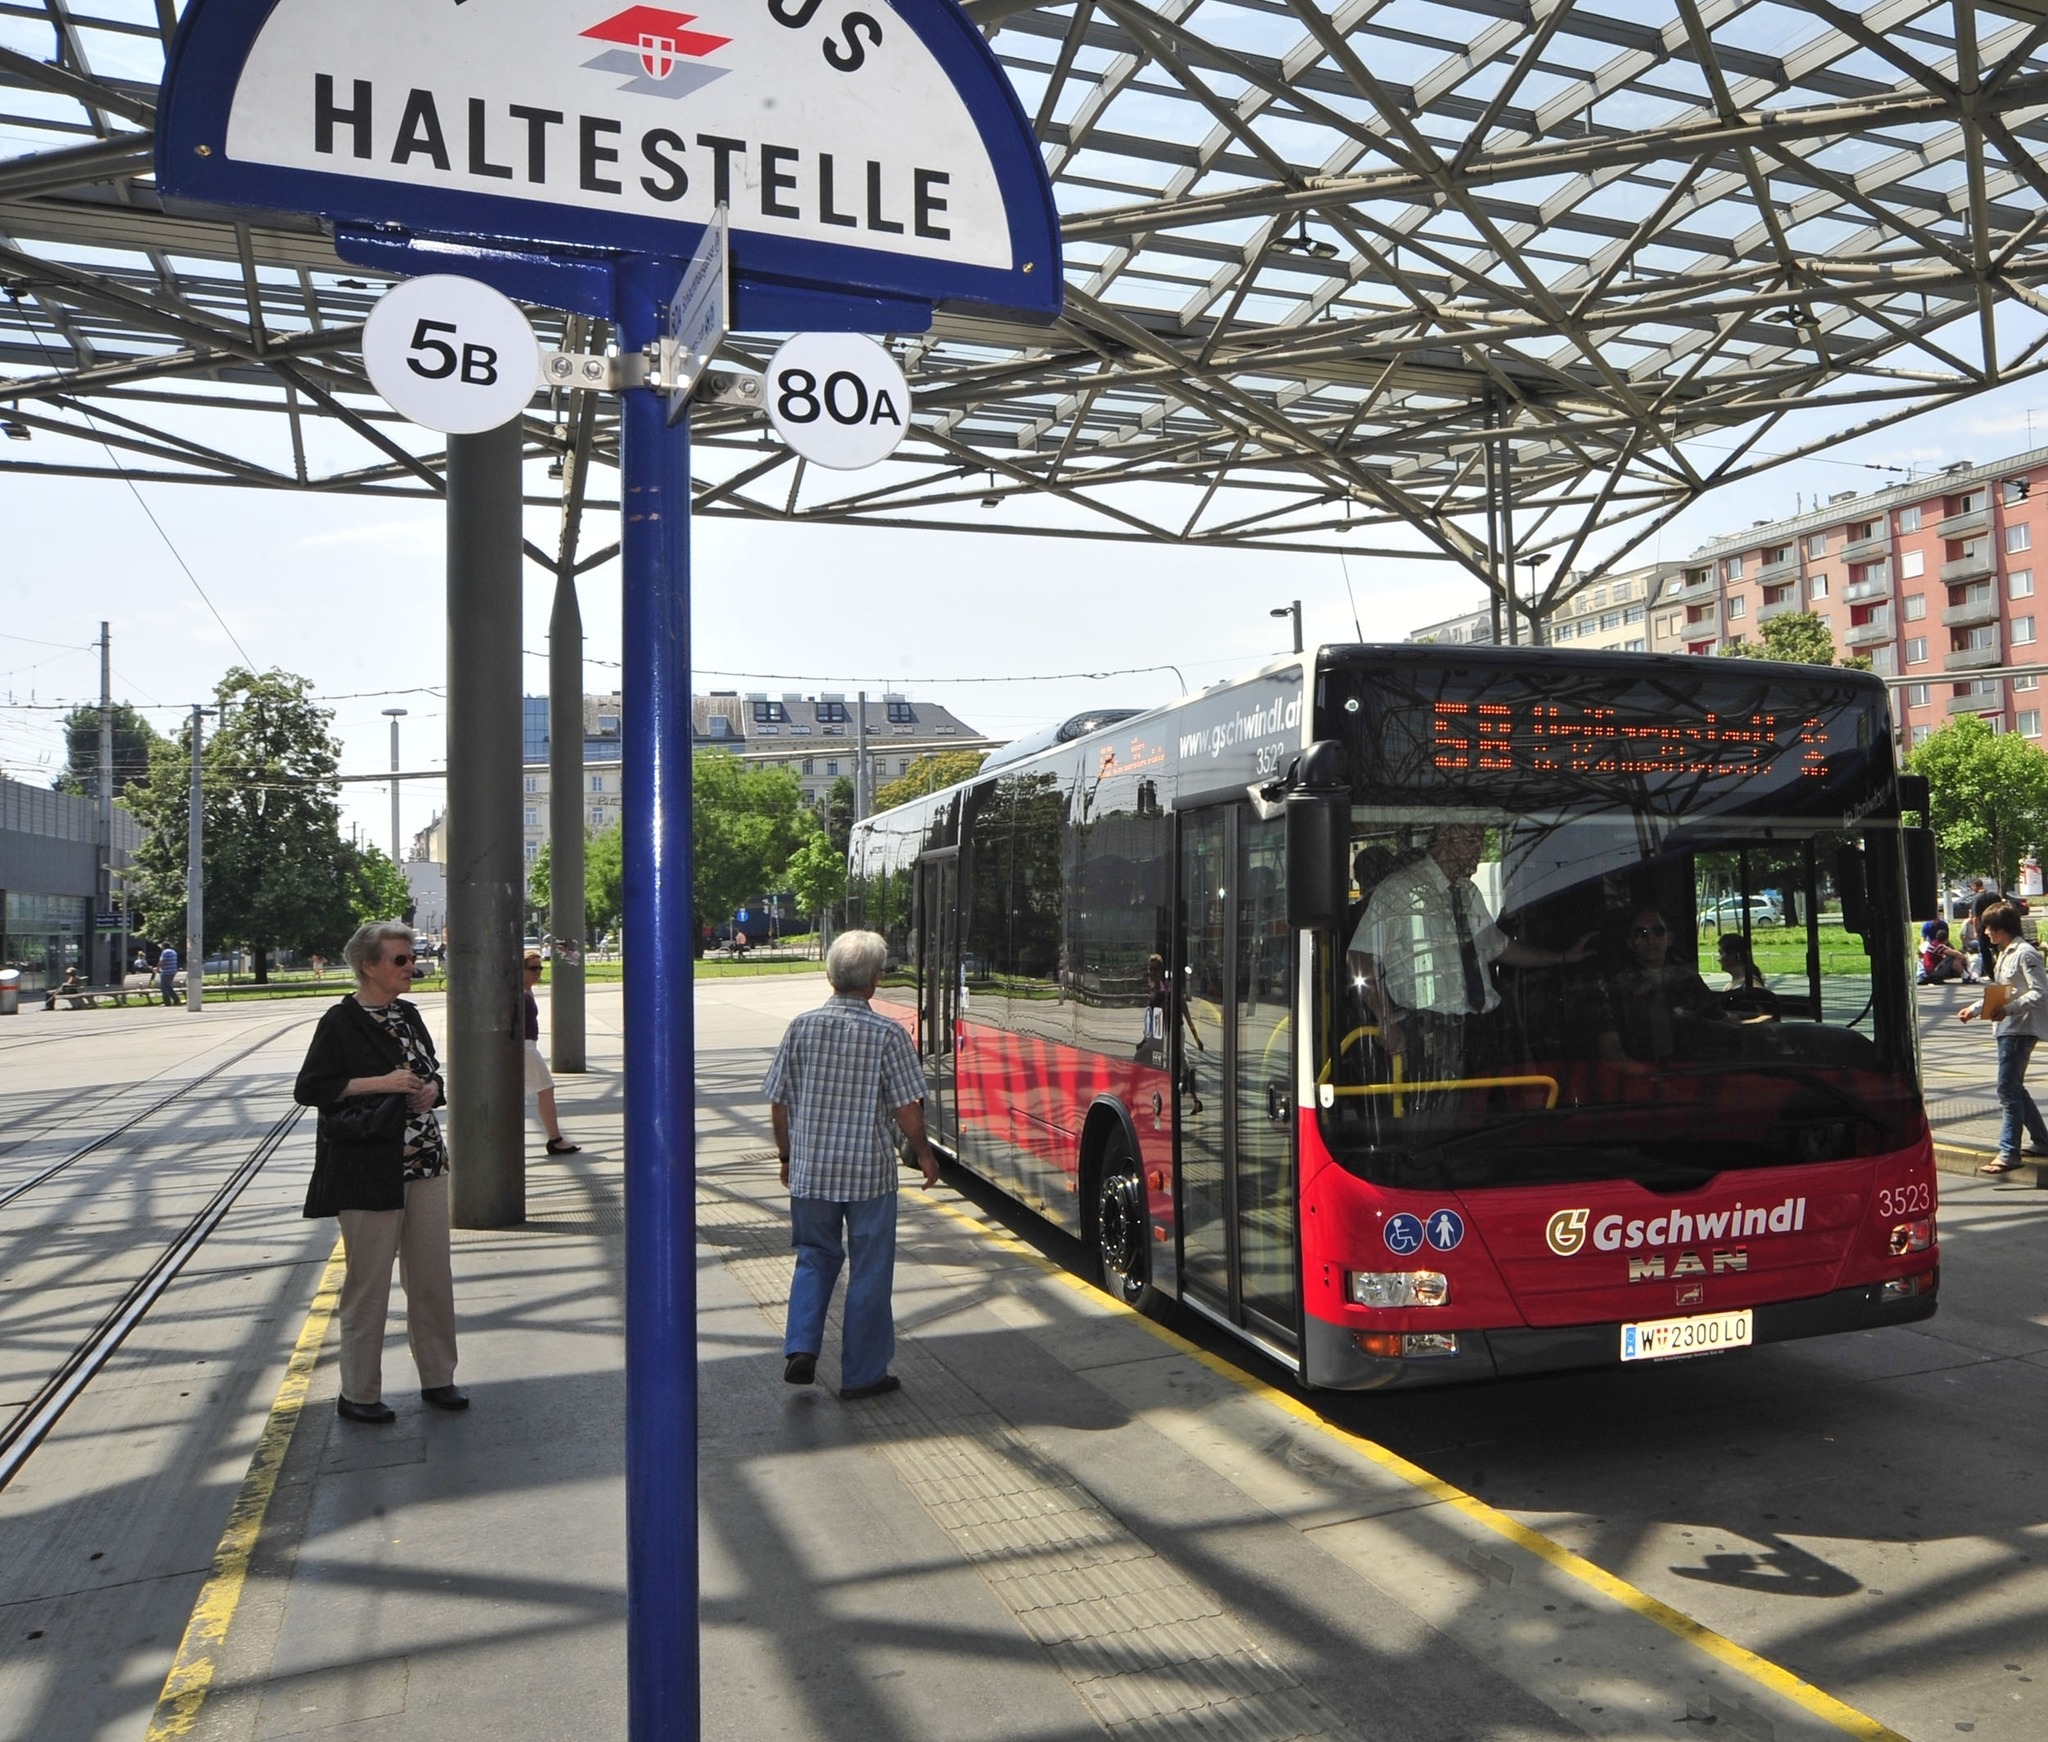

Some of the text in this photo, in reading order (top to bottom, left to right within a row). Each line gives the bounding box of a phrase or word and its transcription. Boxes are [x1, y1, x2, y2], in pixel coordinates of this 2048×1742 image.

[315, 73, 950, 241] HALTESTELLE
[406, 318, 498, 386] 5B
[778, 368, 902, 426] 80A
[1179, 690, 1302, 759] www.gschwindl.at
[1592, 1197, 1806, 1251] Gschwindl
[1878, 1182, 1931, 1218] 3523
[1628, 1245, 1749, 1283] MAN
[1641, 1328, 1655, 1352] W
[1671, 1322, 1719, 1349] 2300
